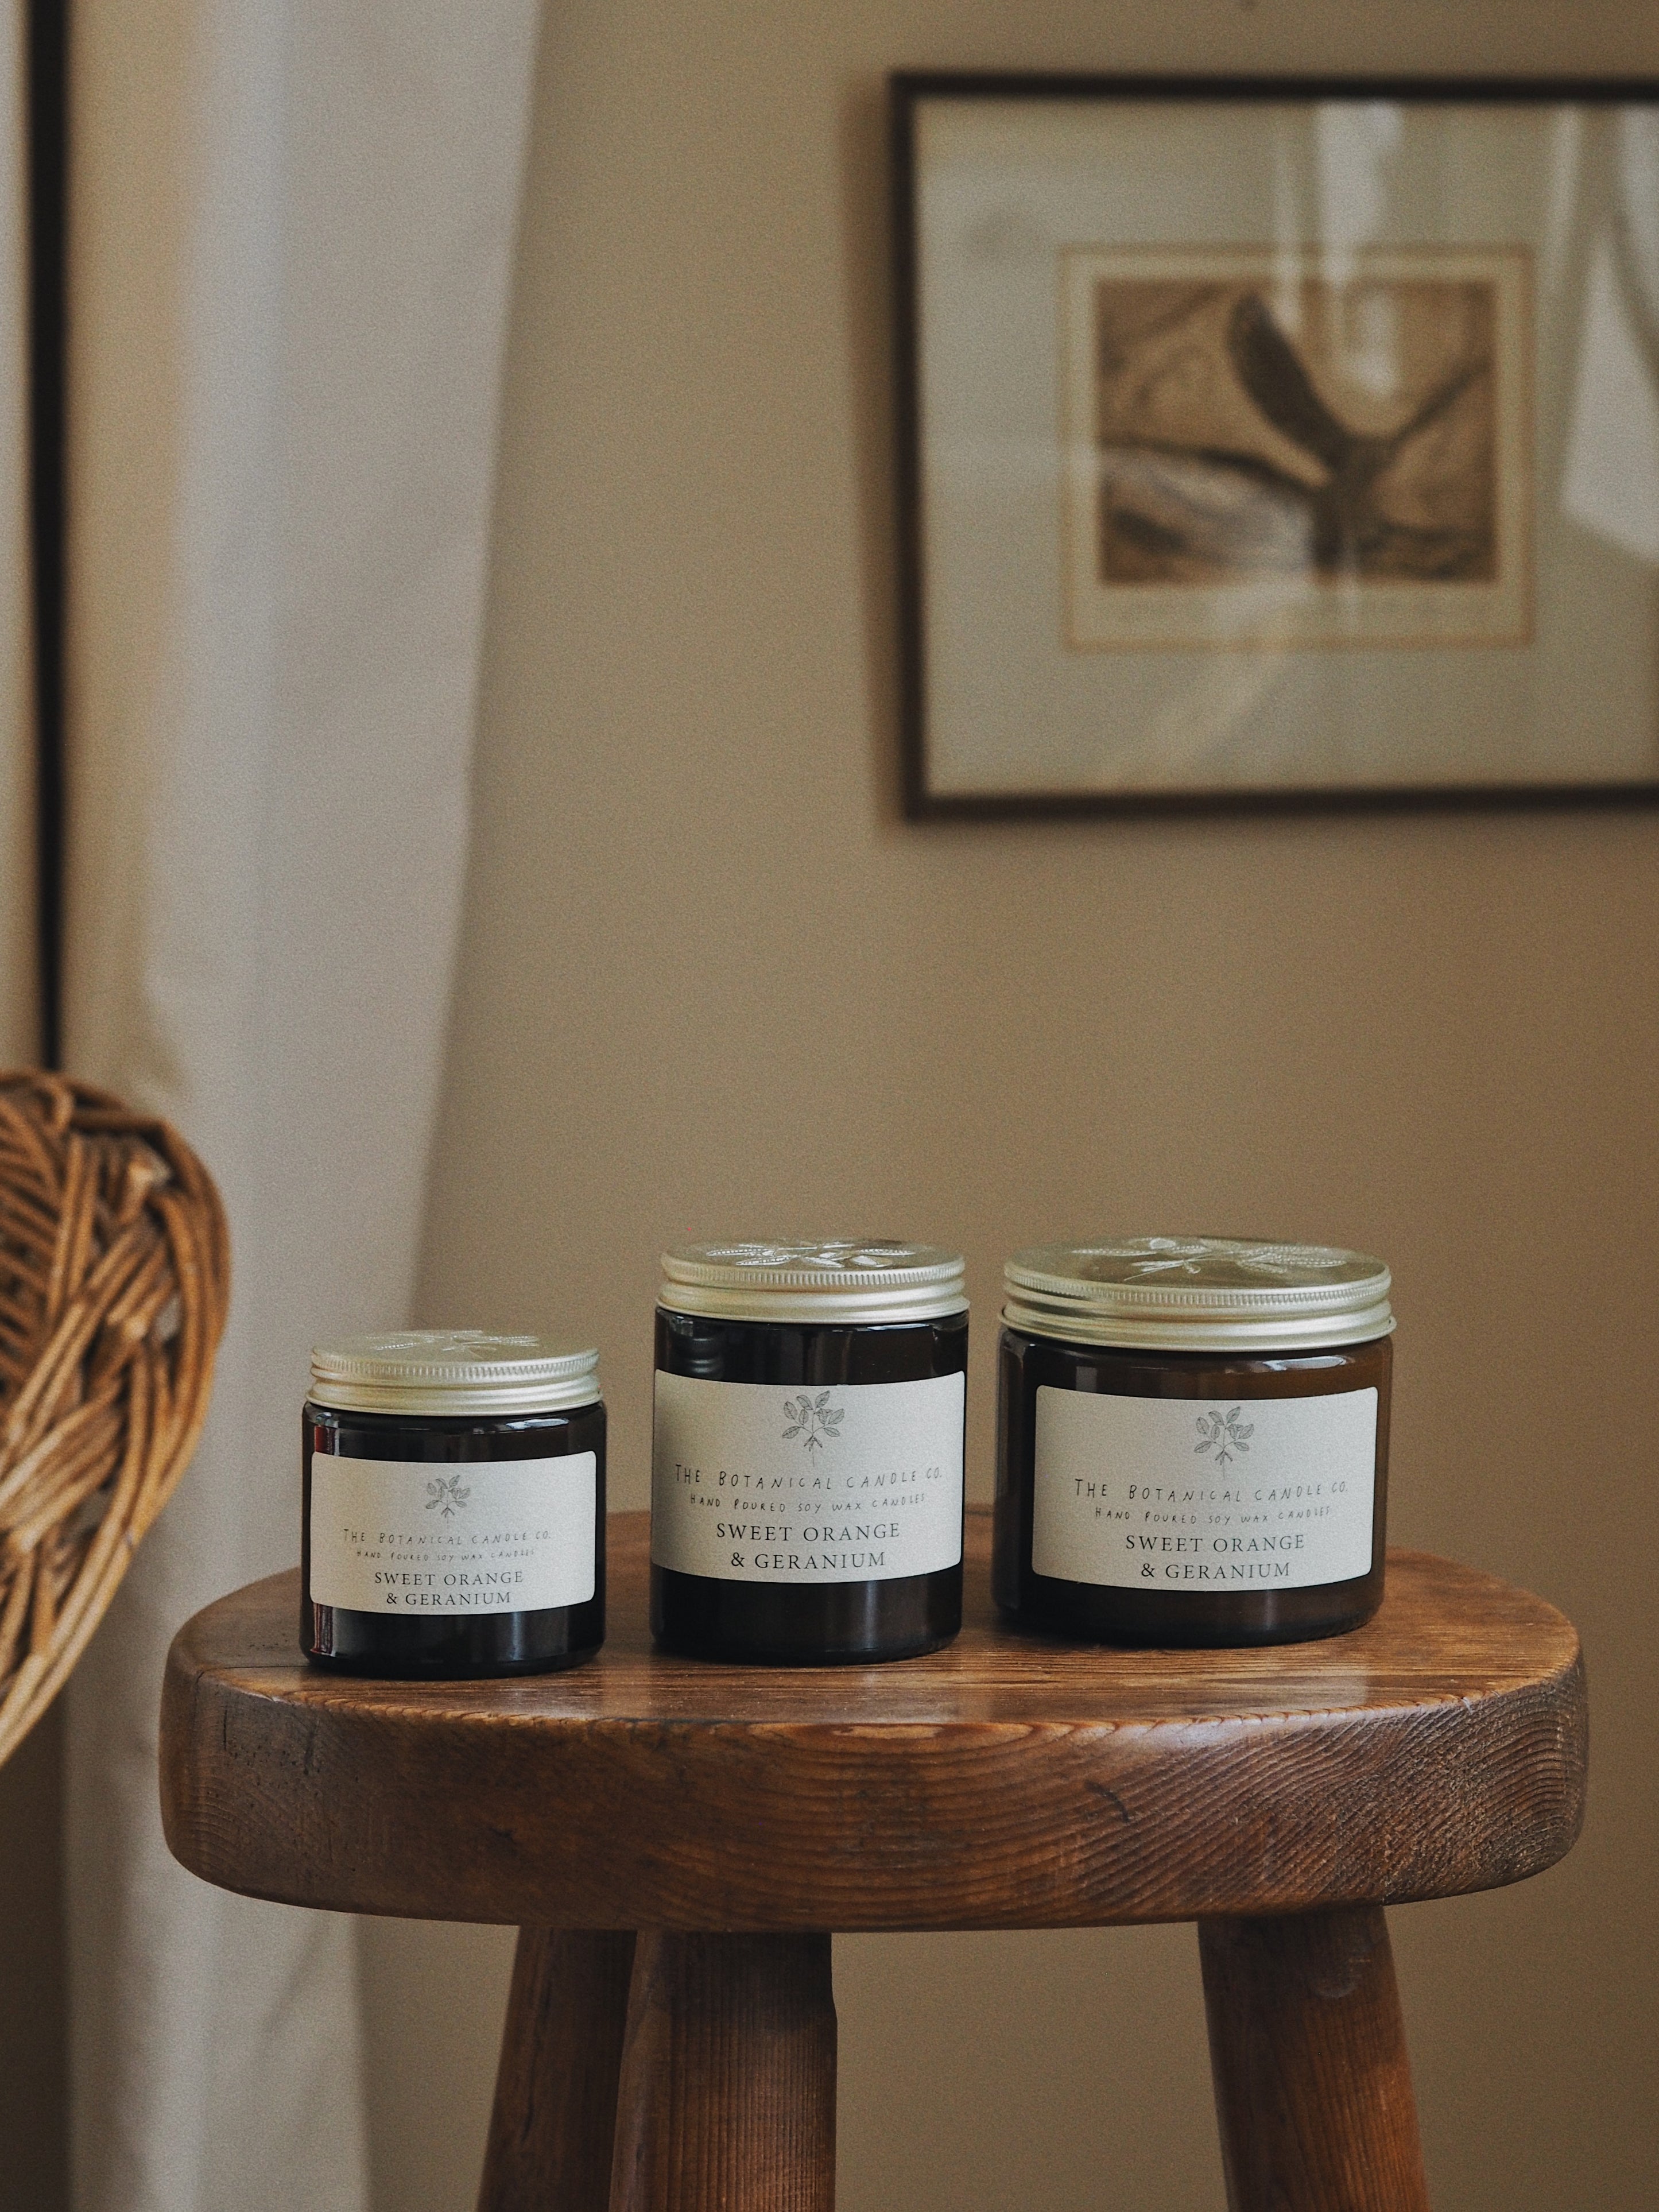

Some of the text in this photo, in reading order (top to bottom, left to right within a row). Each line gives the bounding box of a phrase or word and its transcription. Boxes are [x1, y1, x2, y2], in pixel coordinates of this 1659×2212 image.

[676, 1465, 942, 1490] THE BOTANICAL CANDLE CO.
[1075, 1478, 1348, 1502] THE BOTANICAL CANDLE CO.
[691, 1494, 925, 1513] HAND POURED SOY WAX CANDLES
[1095, 1508, 1130, 1520] HAND
[1208, 1514, 1231, 1525] SOY
[1241, 1514, 1269, 1523] WAX
[1278, 1506, 1331, 1520] CANDLES
[343, 1529, 366, 1542] THE
[380, 1532, 462, 1545] BOTANICAL
[472, 1532, 526, 1543] CANDLE
[716, 1523, 900, 1541] SWEET ORANGE
[1126, 1534, 1305, 1552] SWEET ORANGE
[731, 1551, 885, 1569] & GERANIUM
[375, 1572, 524, 1586] SWEET ORANGE
[1141, 1562, 1290, 1579] & GERANIUM
[386, 1592, 511, 1605] & GERANIUM
